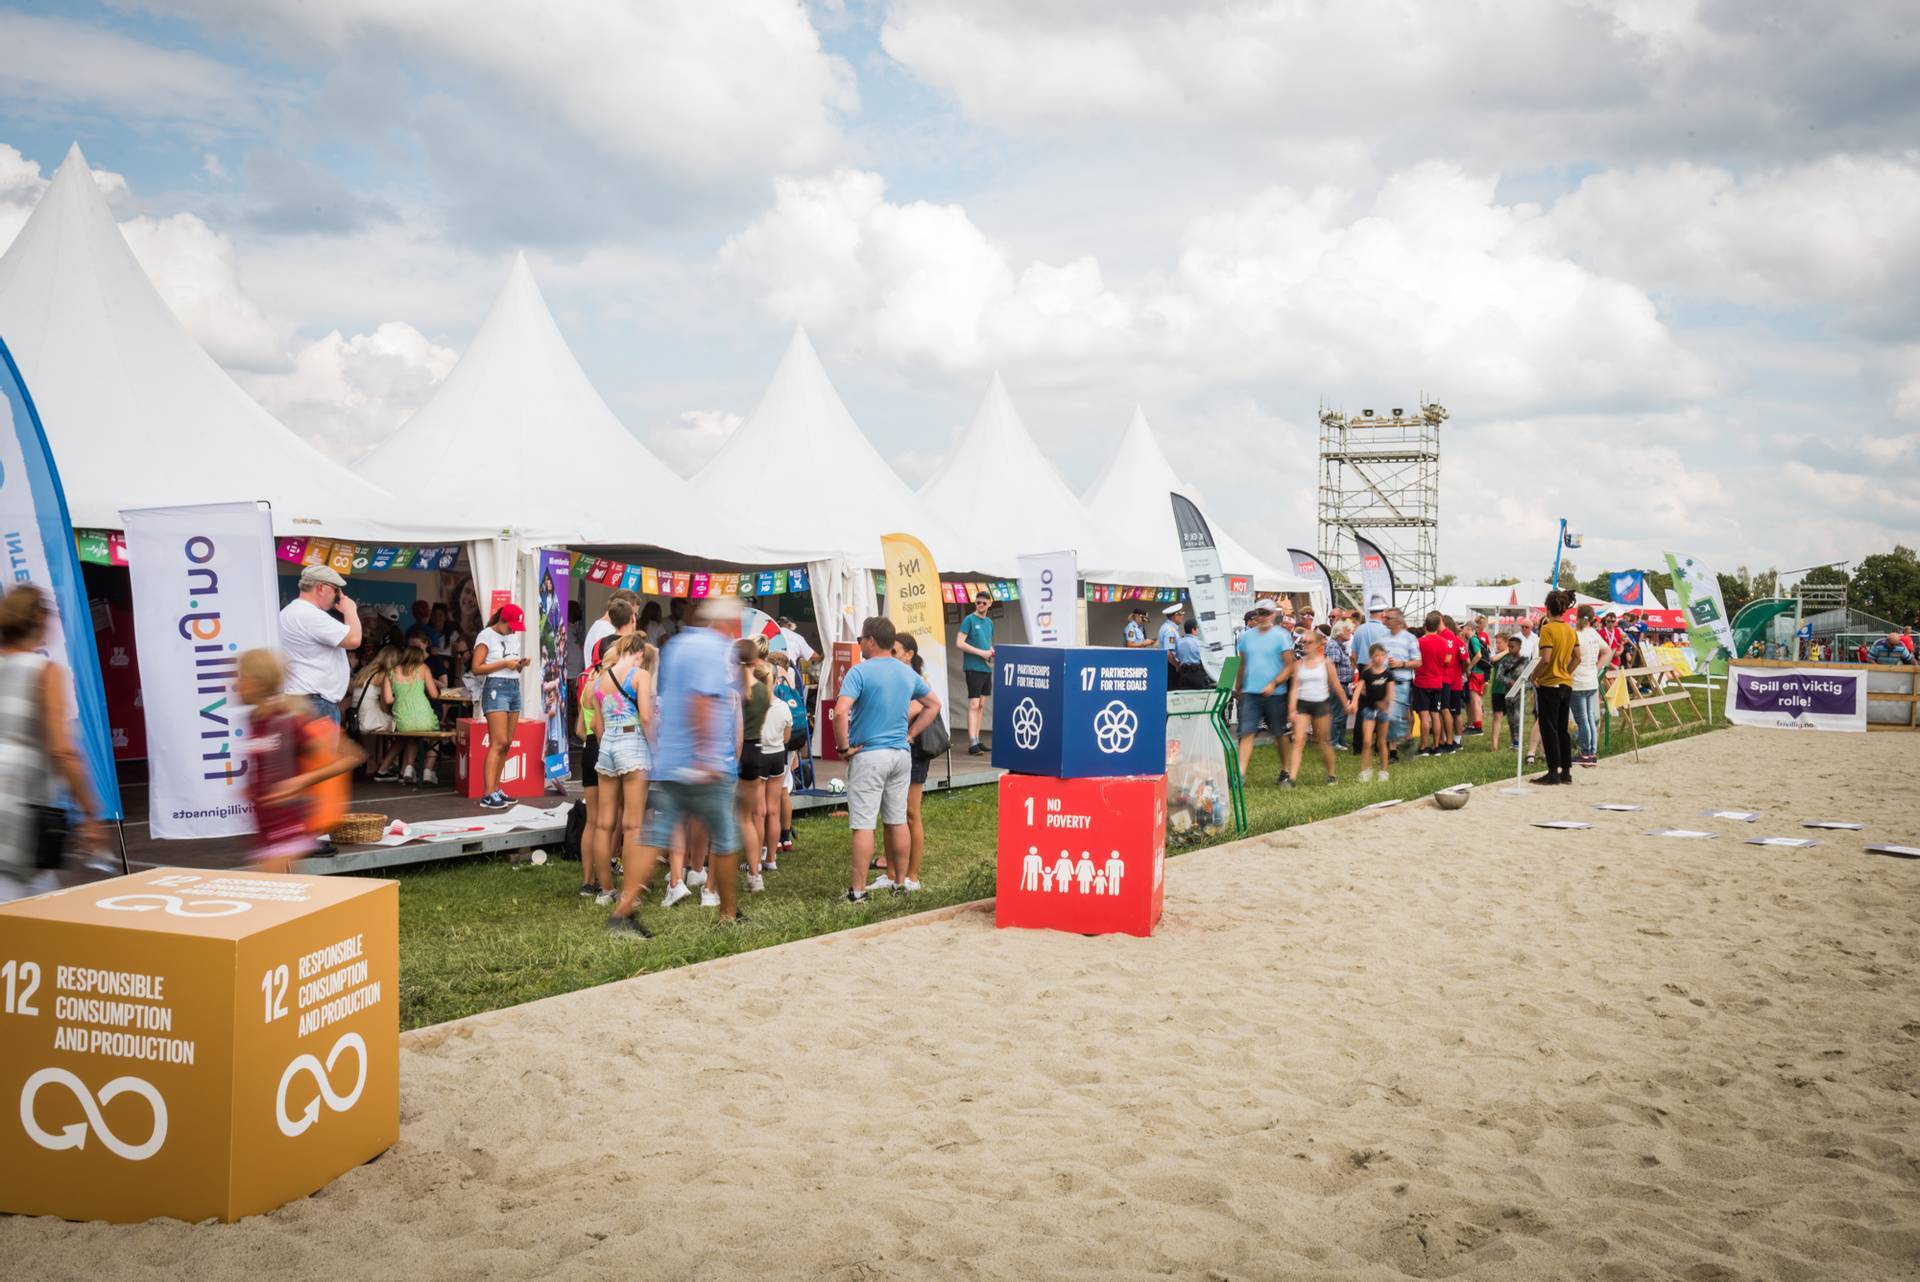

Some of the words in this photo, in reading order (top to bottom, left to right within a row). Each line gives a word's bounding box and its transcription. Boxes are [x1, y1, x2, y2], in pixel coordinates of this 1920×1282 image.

[1004, 663, 1015, 686] 17
[1017, 664, 1050, 677] PARTNERSHIPS
[1017, 676, 1025, 687] FOR
[1034, 678, 1049, 690] GOALS
[1080, 667, 1096, 691] 17
[1100, 667, 1148, 678] PARTNERSHIPS
[1100, 680, 1113, 691] FOR
[1114, 680, 1126, 691] THE
[1126, 680, 1147, 691] GOALS
[1750, 681, 1779, 693] Spill
[1782, 682, 1798, 691] en
[1802, 681, 1842, 695] viktig
[1778, 696, 1811, 707] rolle!
[1024, 797, 1034, 826] 1
[1047, 798, 1061, 812] NO
[1046, 813, 1092, 829] POVERTY
[1, 960, 41, 1016] 12
[56, 965, 164, 1000] RESPONSIBLE
[262, 964, 289, 1024] 12
[298, 933, 363, 980] RESPONSIBLE
[298, 959, 368, 1009] CONSUMPTION
[55, 996, 172, 1032] CONSUMPTION
[298, 1008, 320, 1038] AND
[321, 981, 381, 1028] PRODUCTION
[54, 1026, 88, 1052] AND
[90, 1030, 194, 1065] PRODUCTION
